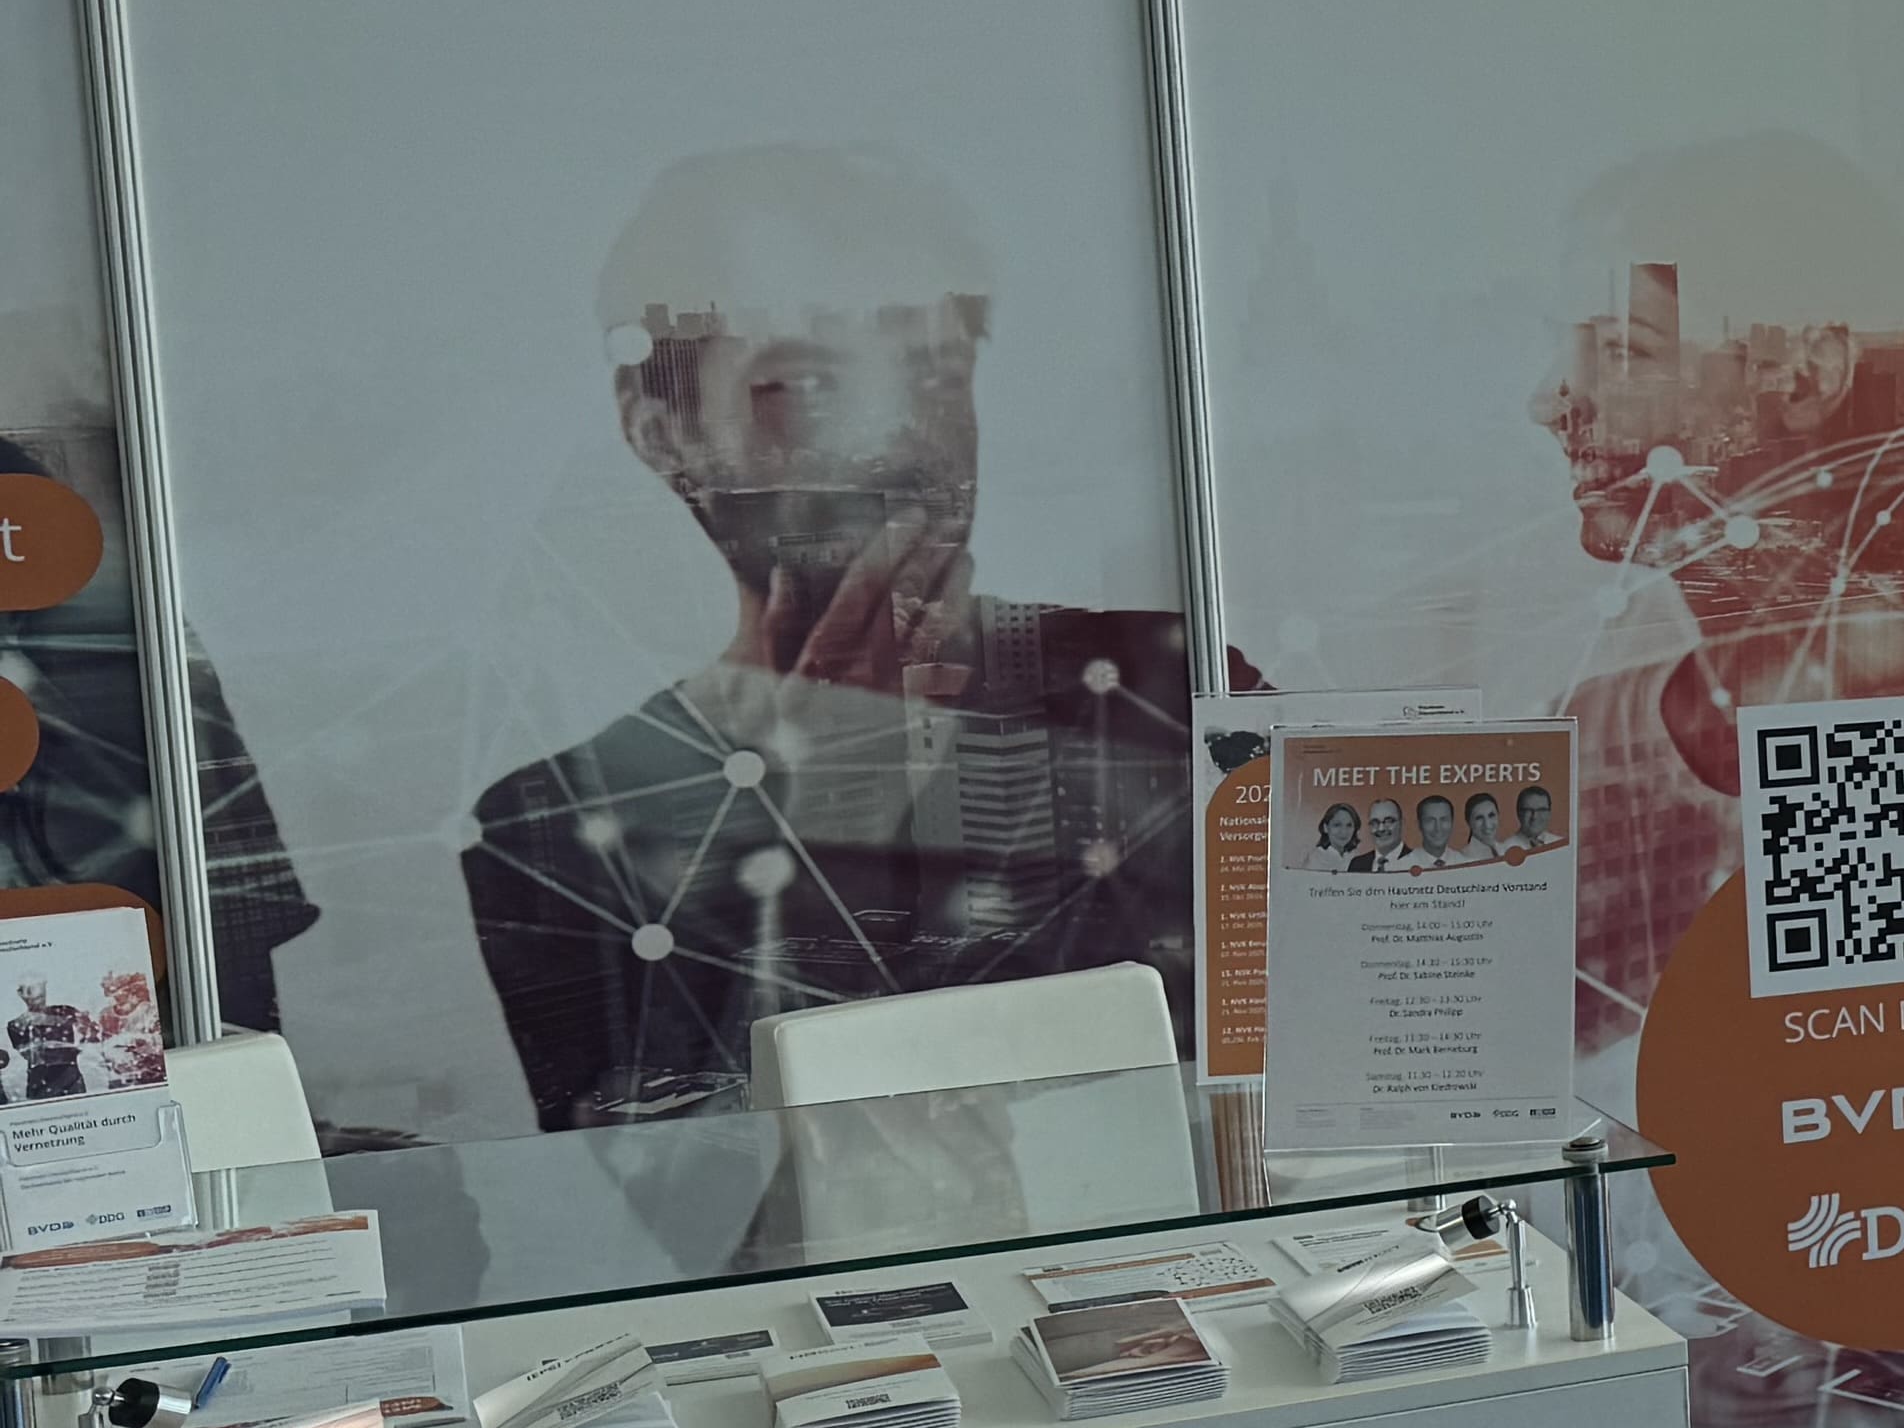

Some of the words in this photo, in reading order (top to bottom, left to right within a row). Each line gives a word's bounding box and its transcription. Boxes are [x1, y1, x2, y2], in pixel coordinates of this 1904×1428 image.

[1313, 767, 1379, 787] MEET
[1386, 765, 1431, 785] THE
[1440, 763, 1540, 783] EXPERTS
[1785, 1002, 1885, 1043] SCAN
[13, 1128, 45, 1140] Mehr
[49, 1121, 98, 1134] Qualität
[102, 1115, 136, 1126] durch
[14, 1136, 85, 1152] Vernetzung
